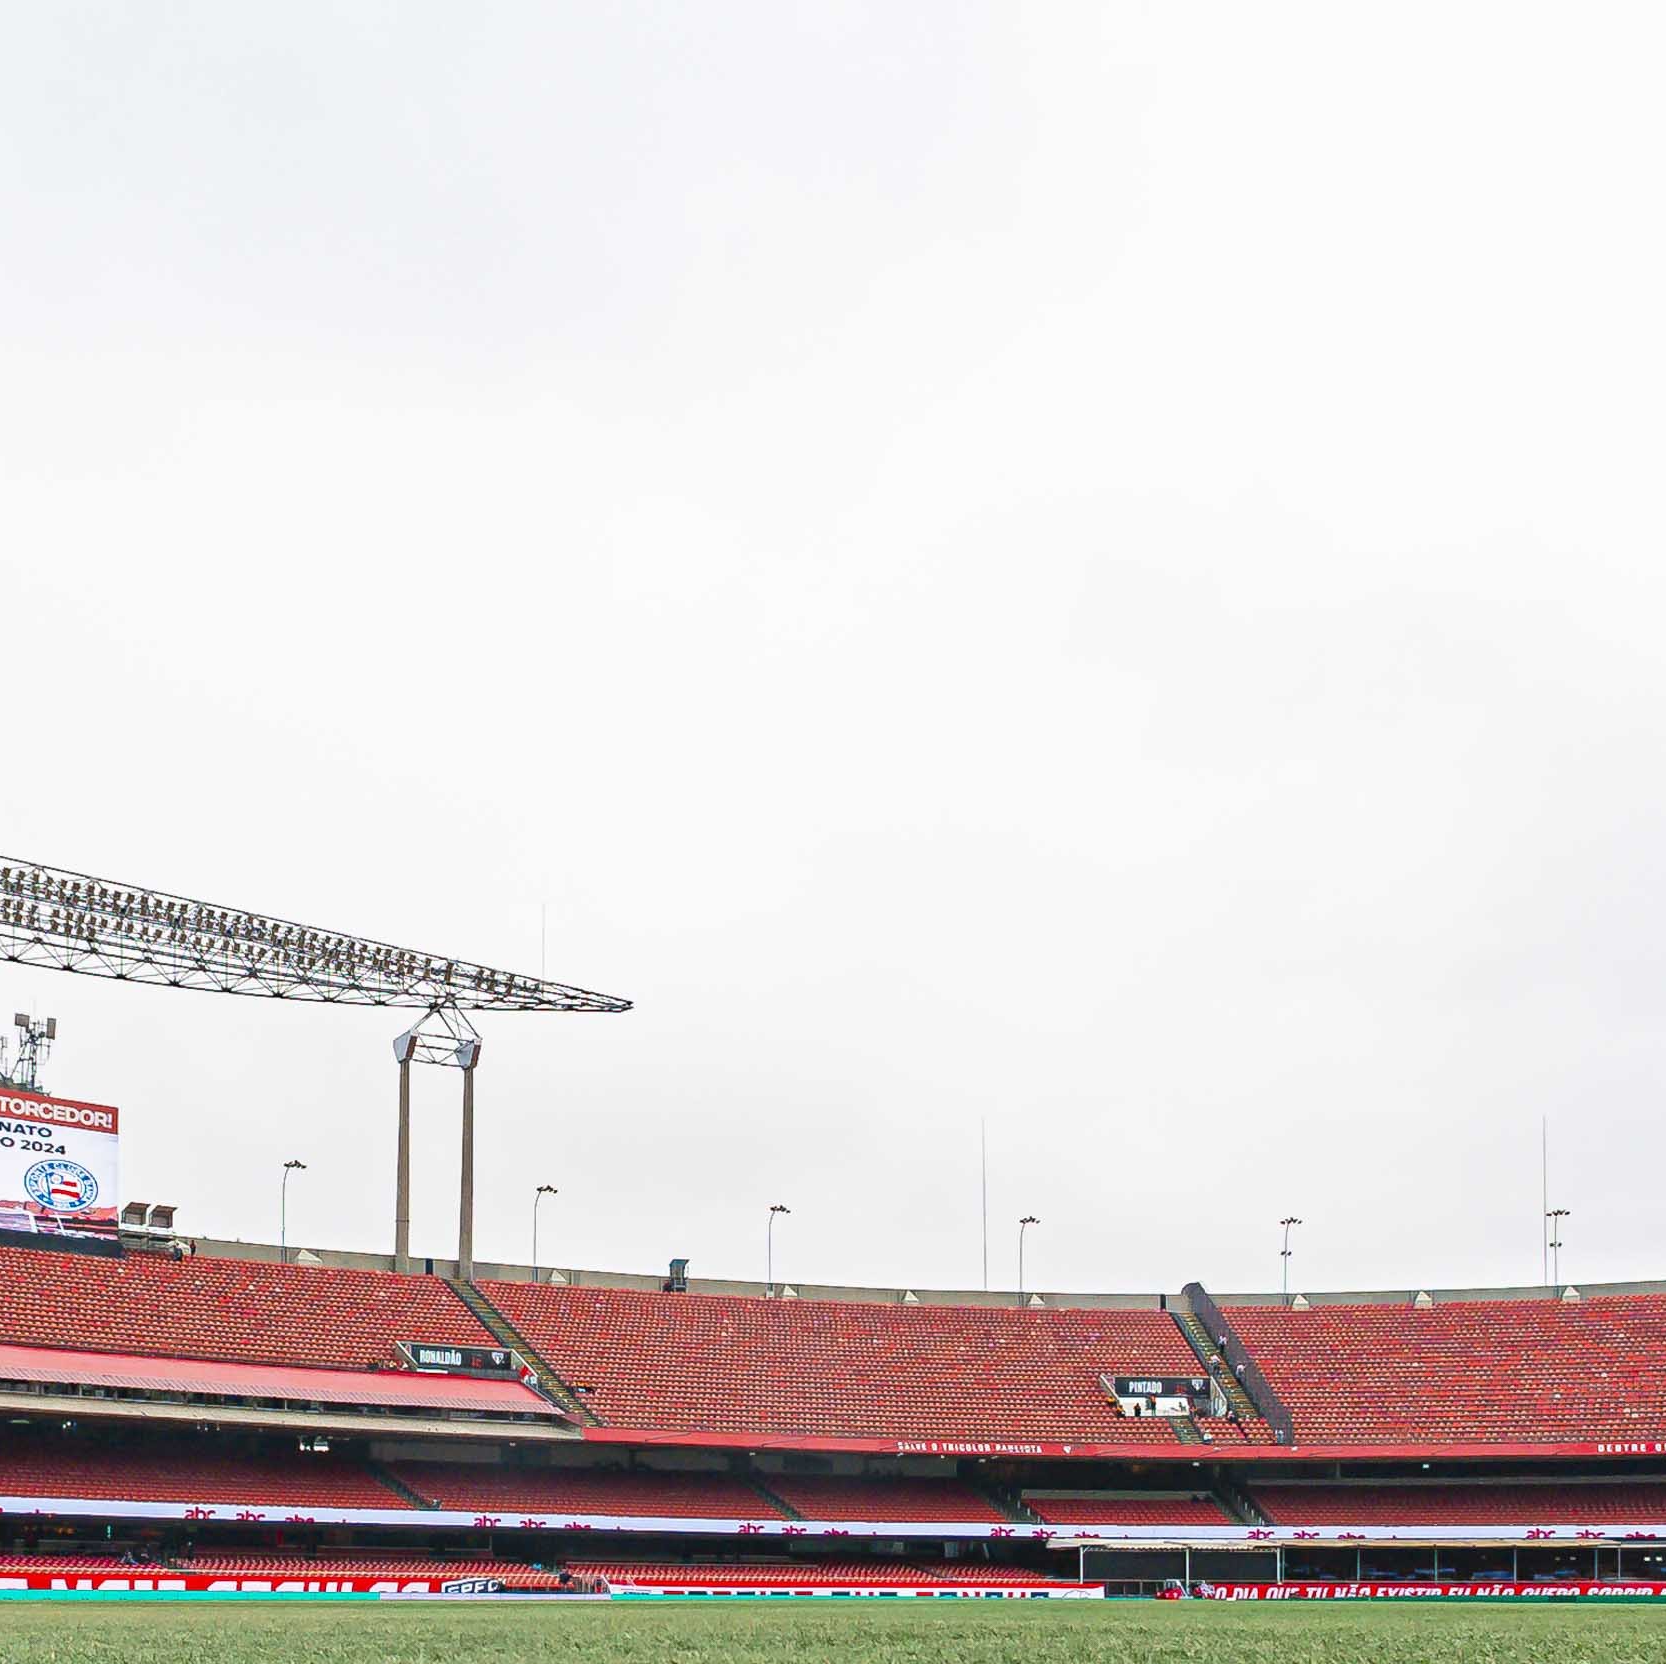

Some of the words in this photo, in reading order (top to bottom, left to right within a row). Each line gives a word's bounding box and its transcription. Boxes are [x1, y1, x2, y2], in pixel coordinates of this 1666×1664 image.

[21, 1140, 66, 1155] 2024
[419, 1350, 462, 1365] RONALDÃO
[1129, 1381, 1162, 1393] PINTADO
[184, 1507, 216, 1520] abc
[473, 1515, 501, 1528] abc
[738, 1523, 764, 1535] abc
[990, 1526, 1015, 1537] abc
[1247, 1528, 1274, 1539] abc
[1525, 1528, 1556, 1539] abc
